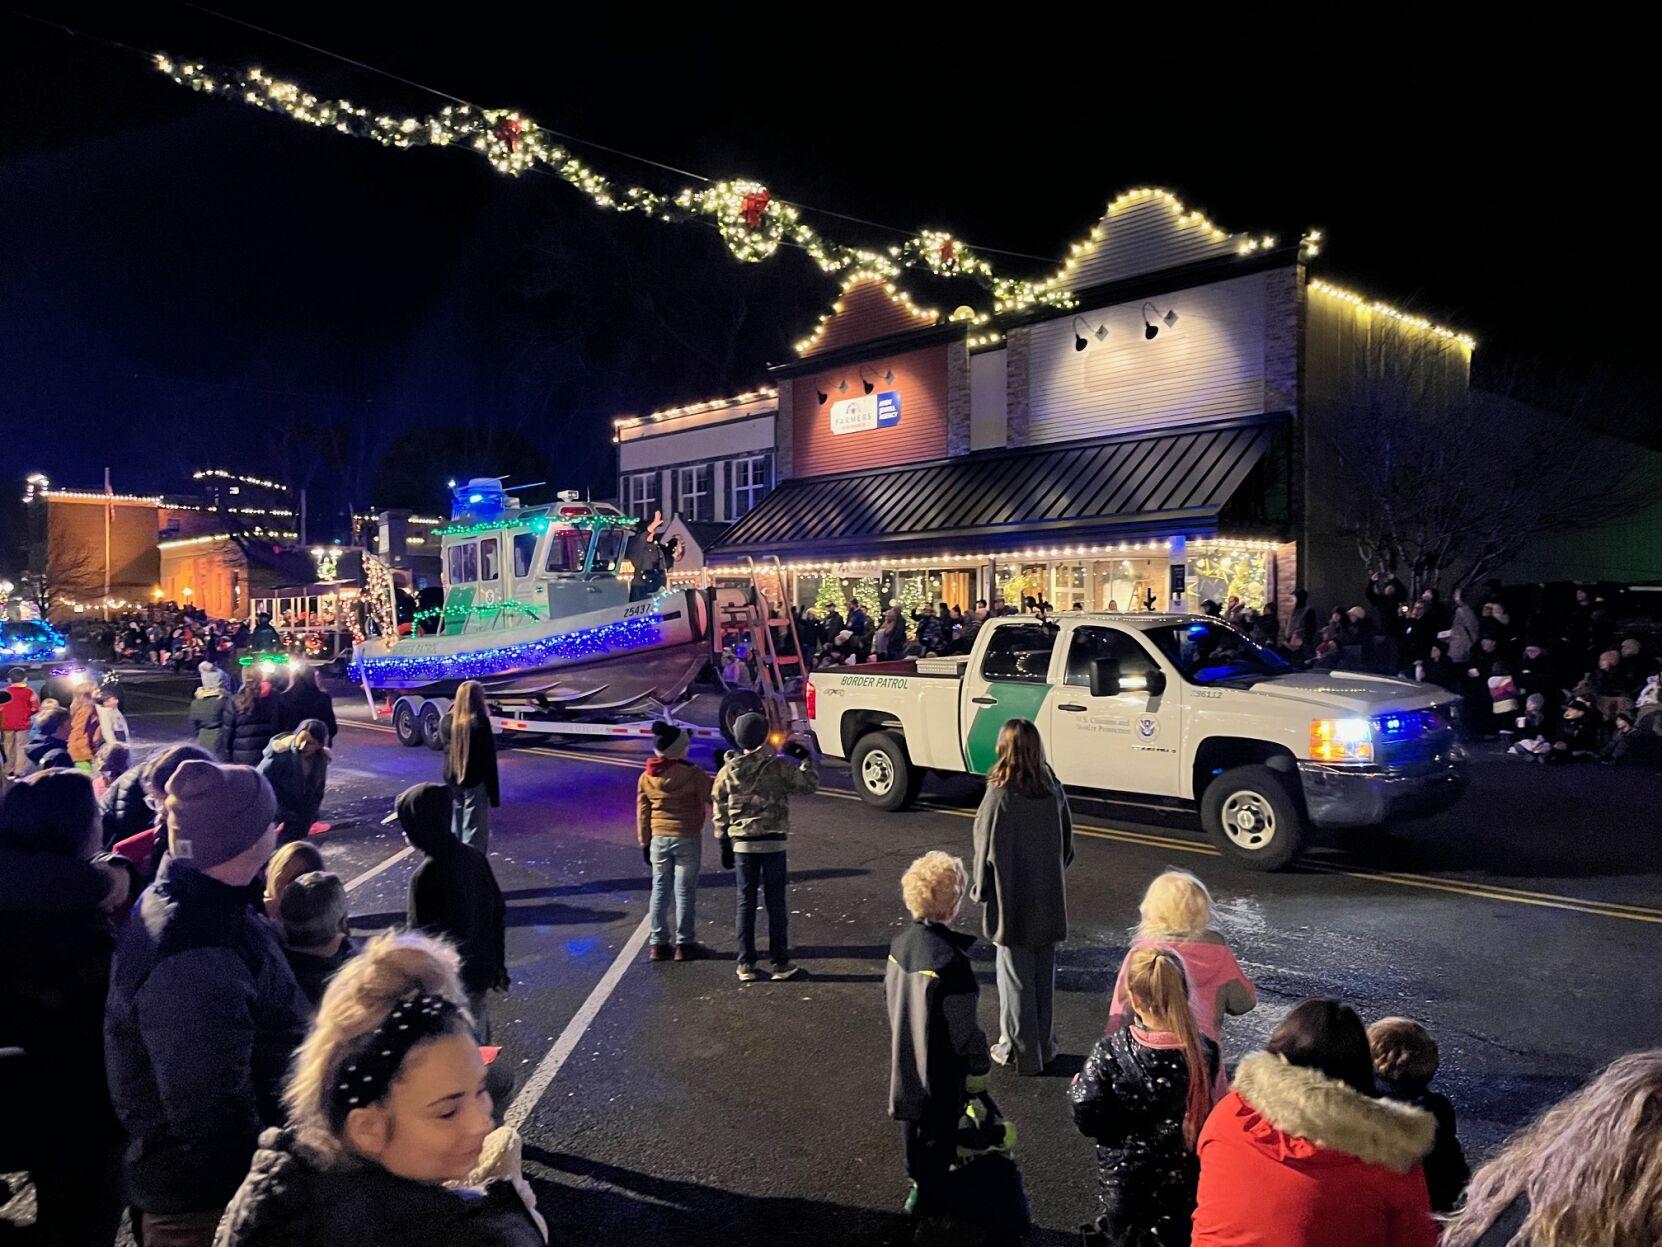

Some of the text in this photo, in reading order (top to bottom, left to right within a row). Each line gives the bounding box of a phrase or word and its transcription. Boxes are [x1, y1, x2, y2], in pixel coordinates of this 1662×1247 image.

[836, 412, 872, 425] FARMERS
[623, 603, 651, 618] 25437
[841, 676, 909, 689] BORDER PATROL
